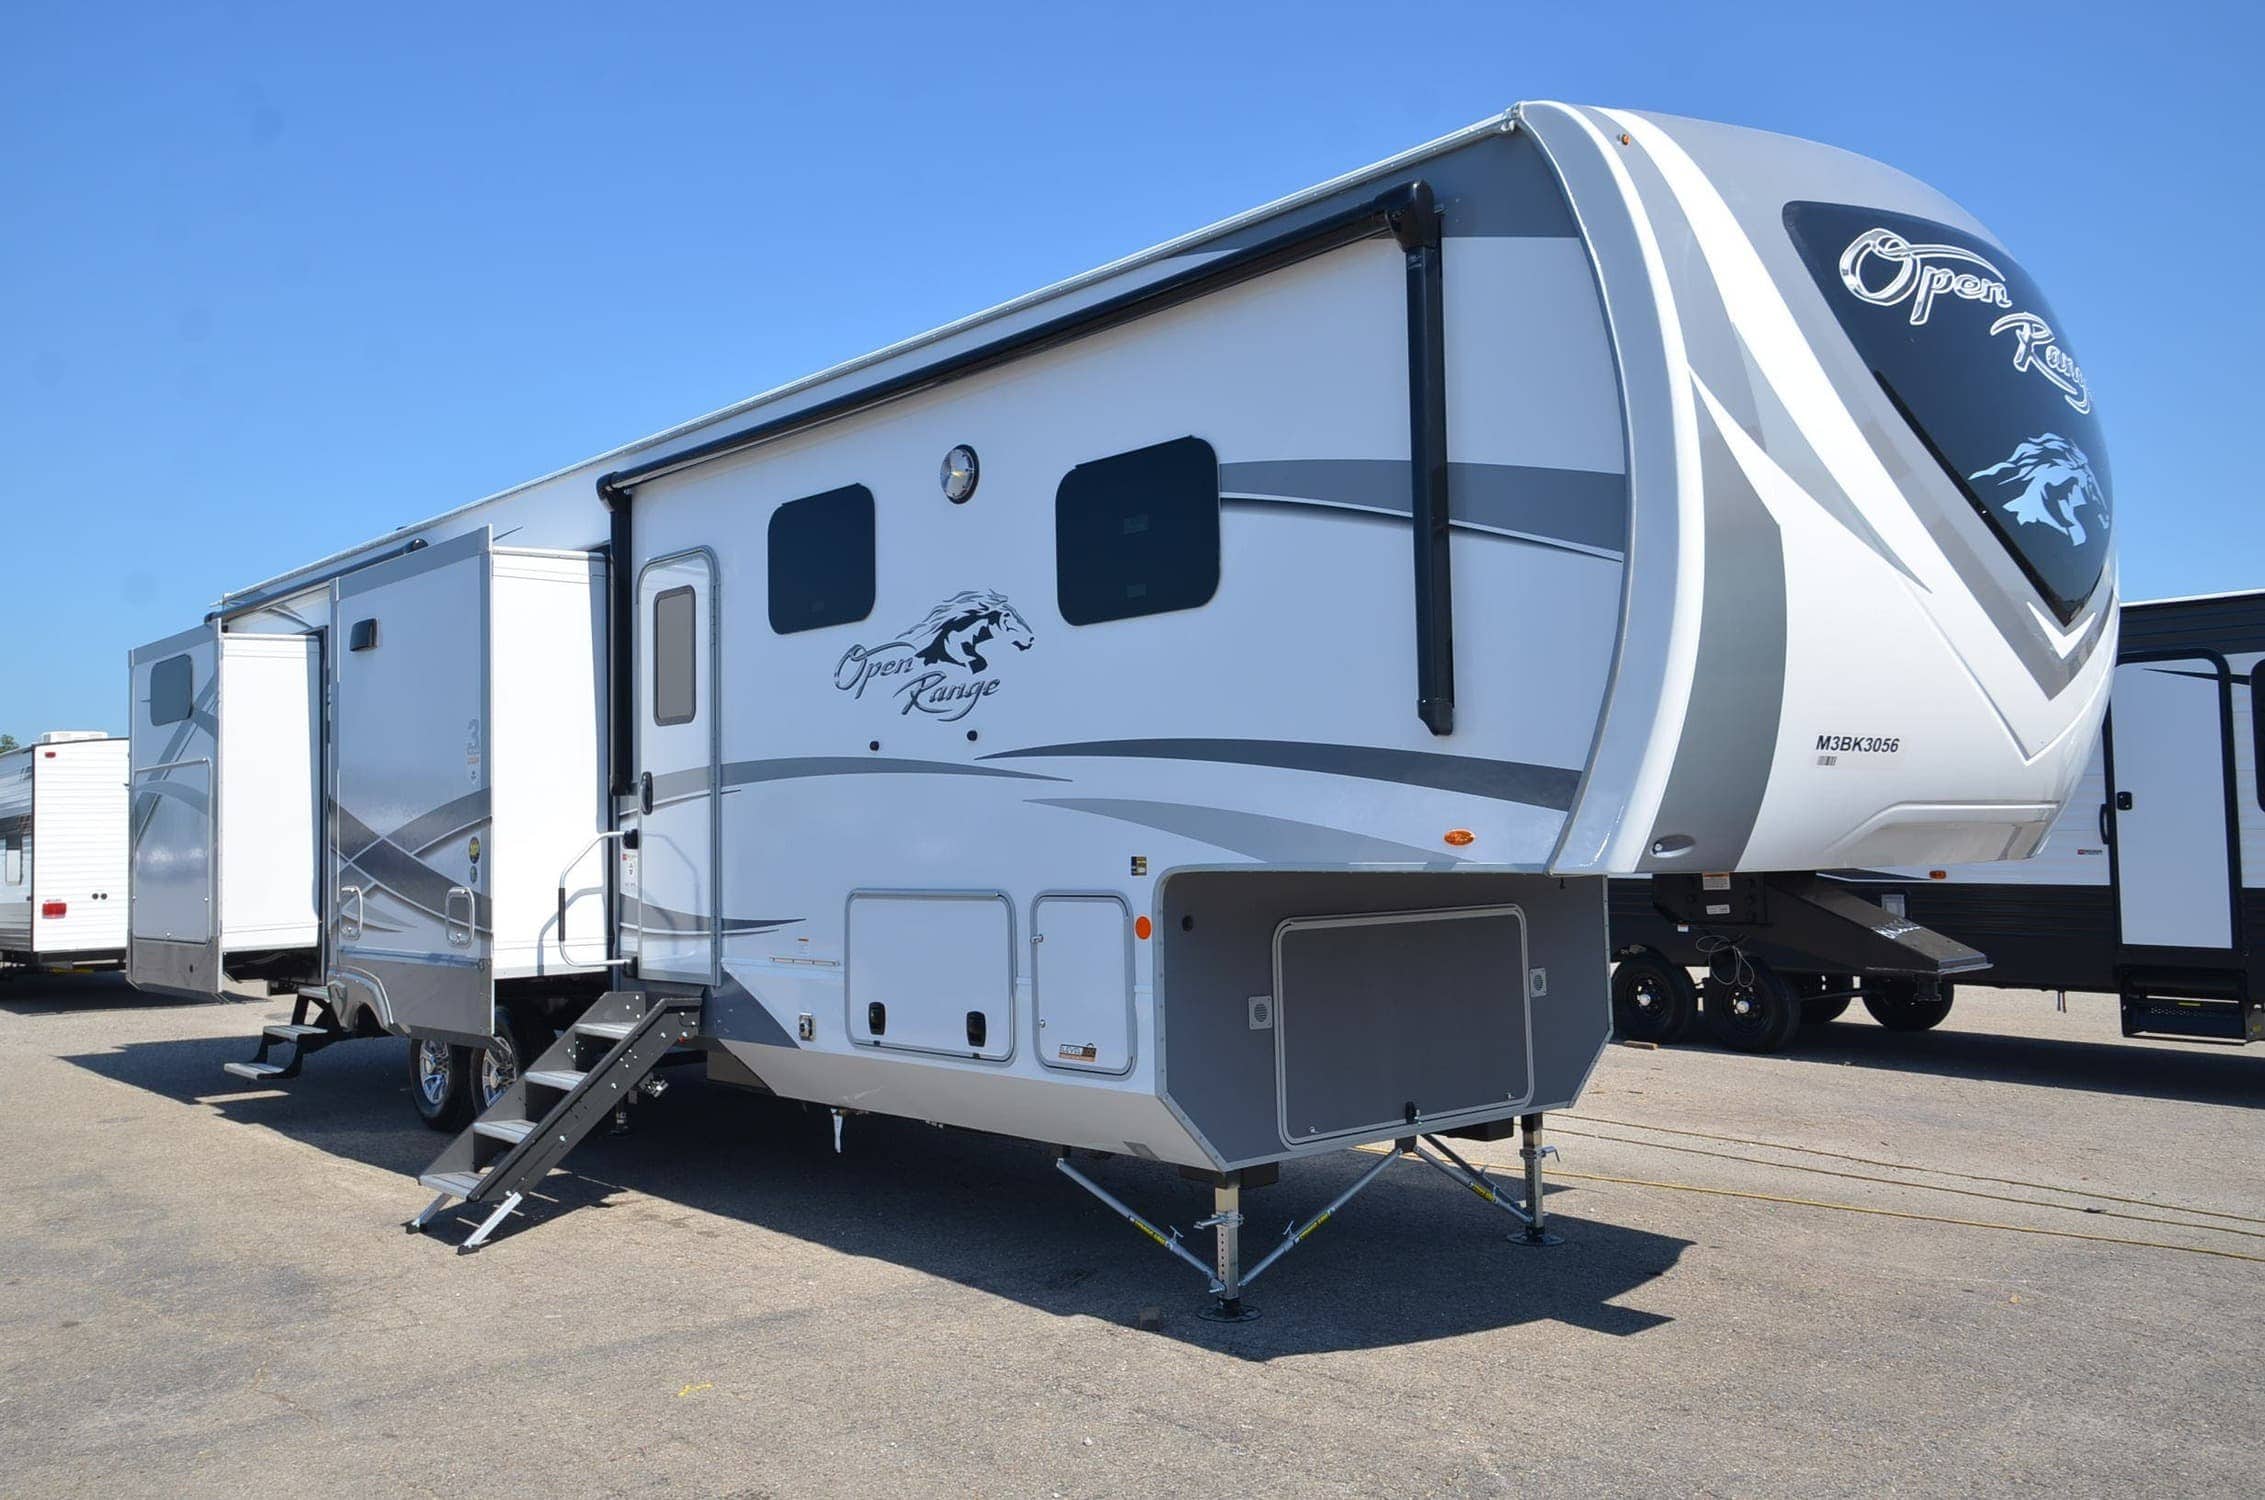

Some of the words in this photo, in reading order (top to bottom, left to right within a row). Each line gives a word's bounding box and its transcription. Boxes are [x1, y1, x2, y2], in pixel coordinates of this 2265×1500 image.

[1839, 228, 2012, 325] Open
[834, 641, 917, 700] Open
[892, 670, 1001, 722] Range
[1816, 735, 1900, 752] M3BK3056
